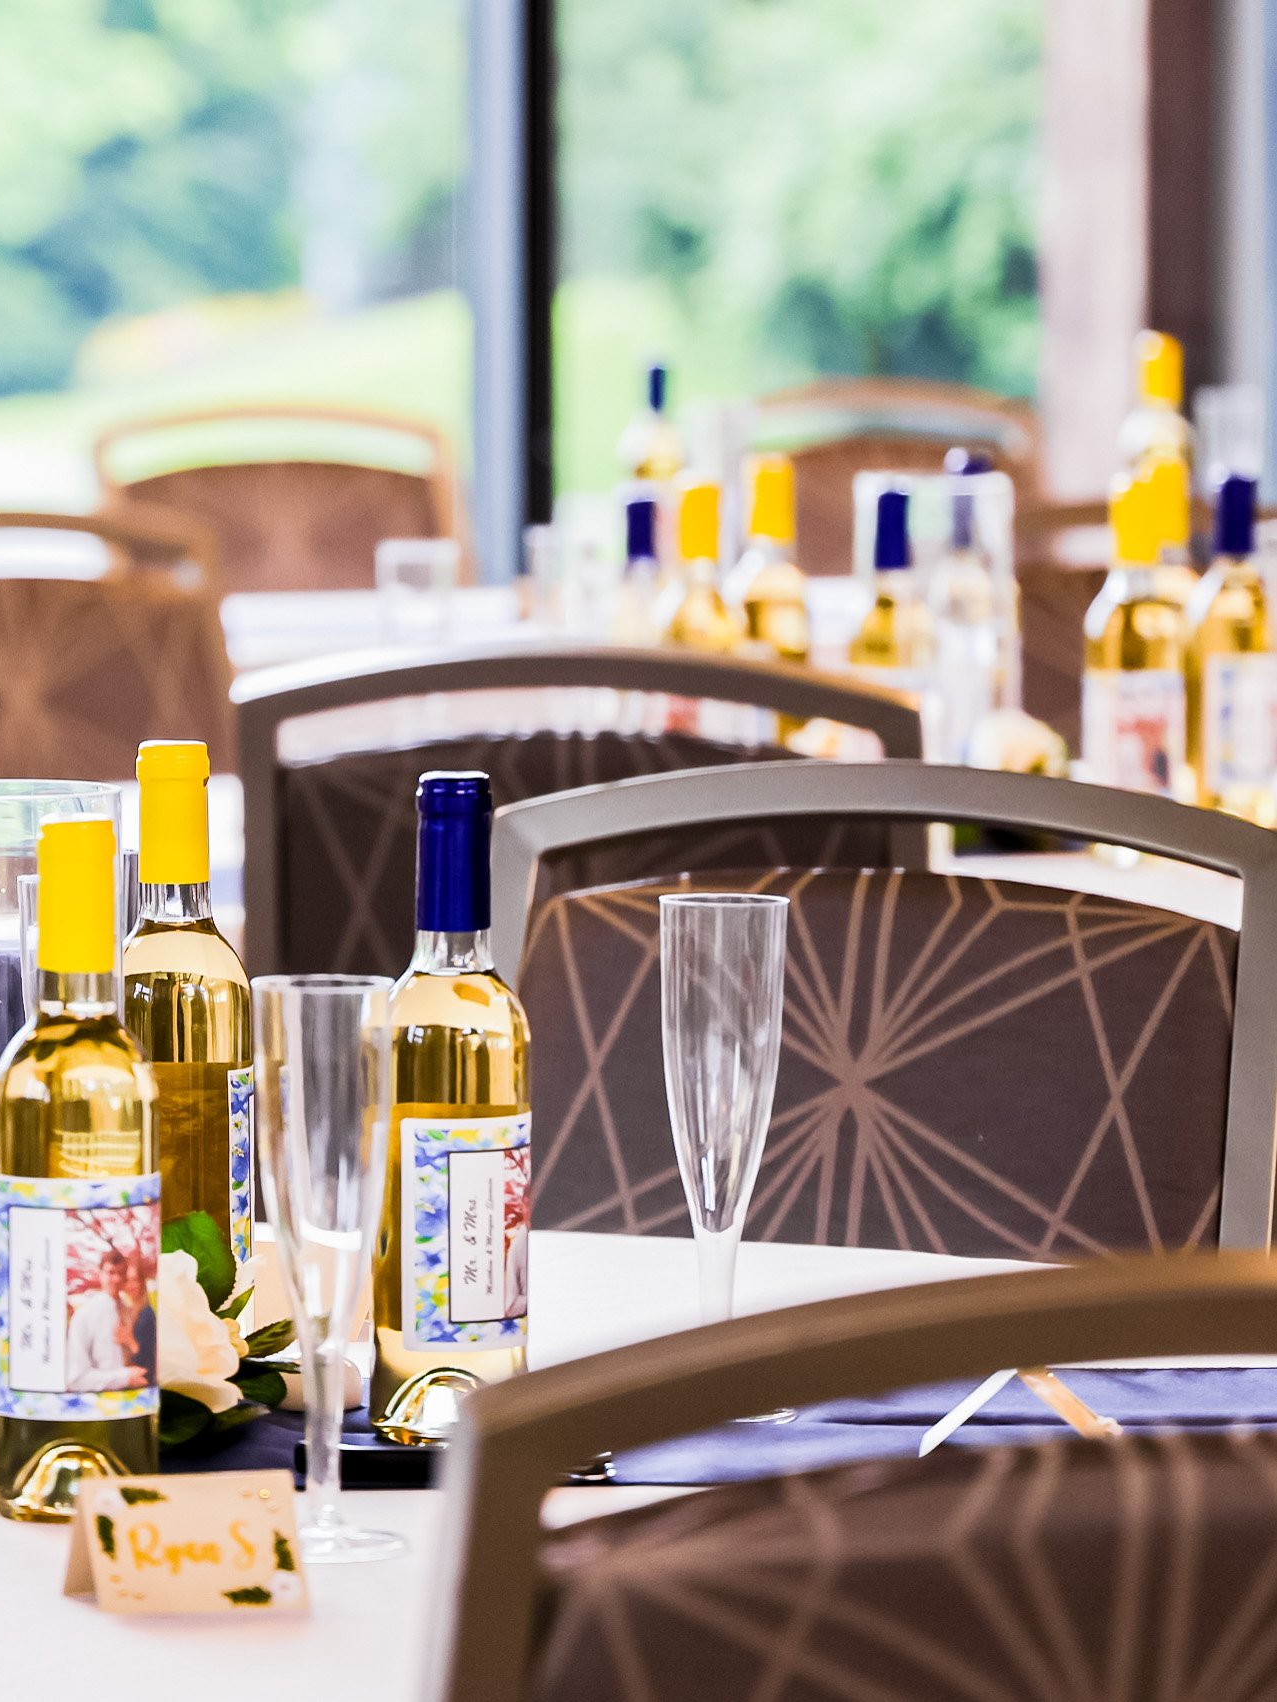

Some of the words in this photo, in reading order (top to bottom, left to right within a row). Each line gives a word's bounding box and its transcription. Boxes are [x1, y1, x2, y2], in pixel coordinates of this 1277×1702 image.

[462, 1235, 477, 1246] &
[128, 1521, 222, 1576] Ryan
[228, 1520, 256, 1571] S
